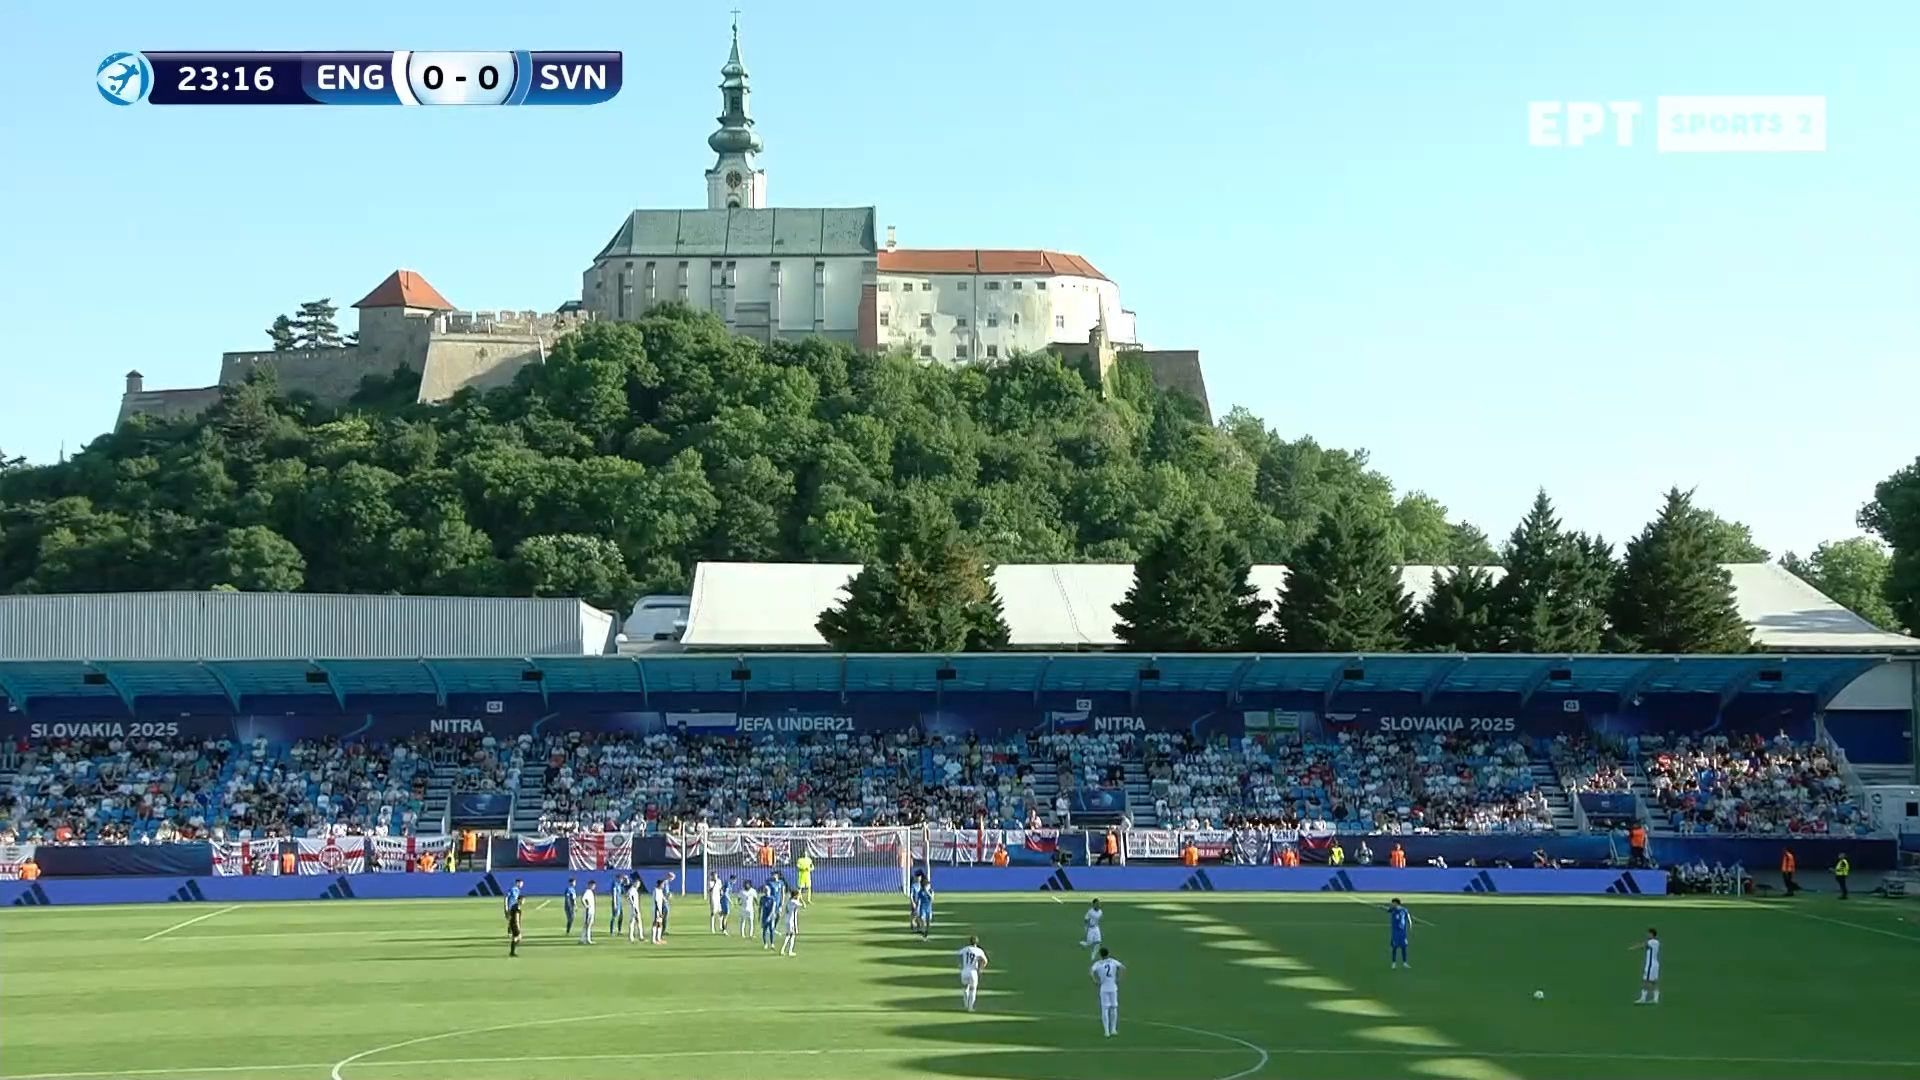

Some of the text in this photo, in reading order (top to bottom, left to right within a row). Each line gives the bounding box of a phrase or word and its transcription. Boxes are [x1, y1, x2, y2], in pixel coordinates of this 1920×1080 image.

[30, 722, 179, 738] SLOVAKIA 2025
[430, 718, 484, 733] NITRA
[777, 717, 855, 731] UNDER21
[1094, 716, 1146, 731] NITRA
[1380, 716, 1516, 732] SLOVAKIA 2025
[966, 951, 976, 964] 19
[1104, 964, 1112, 977] 2
